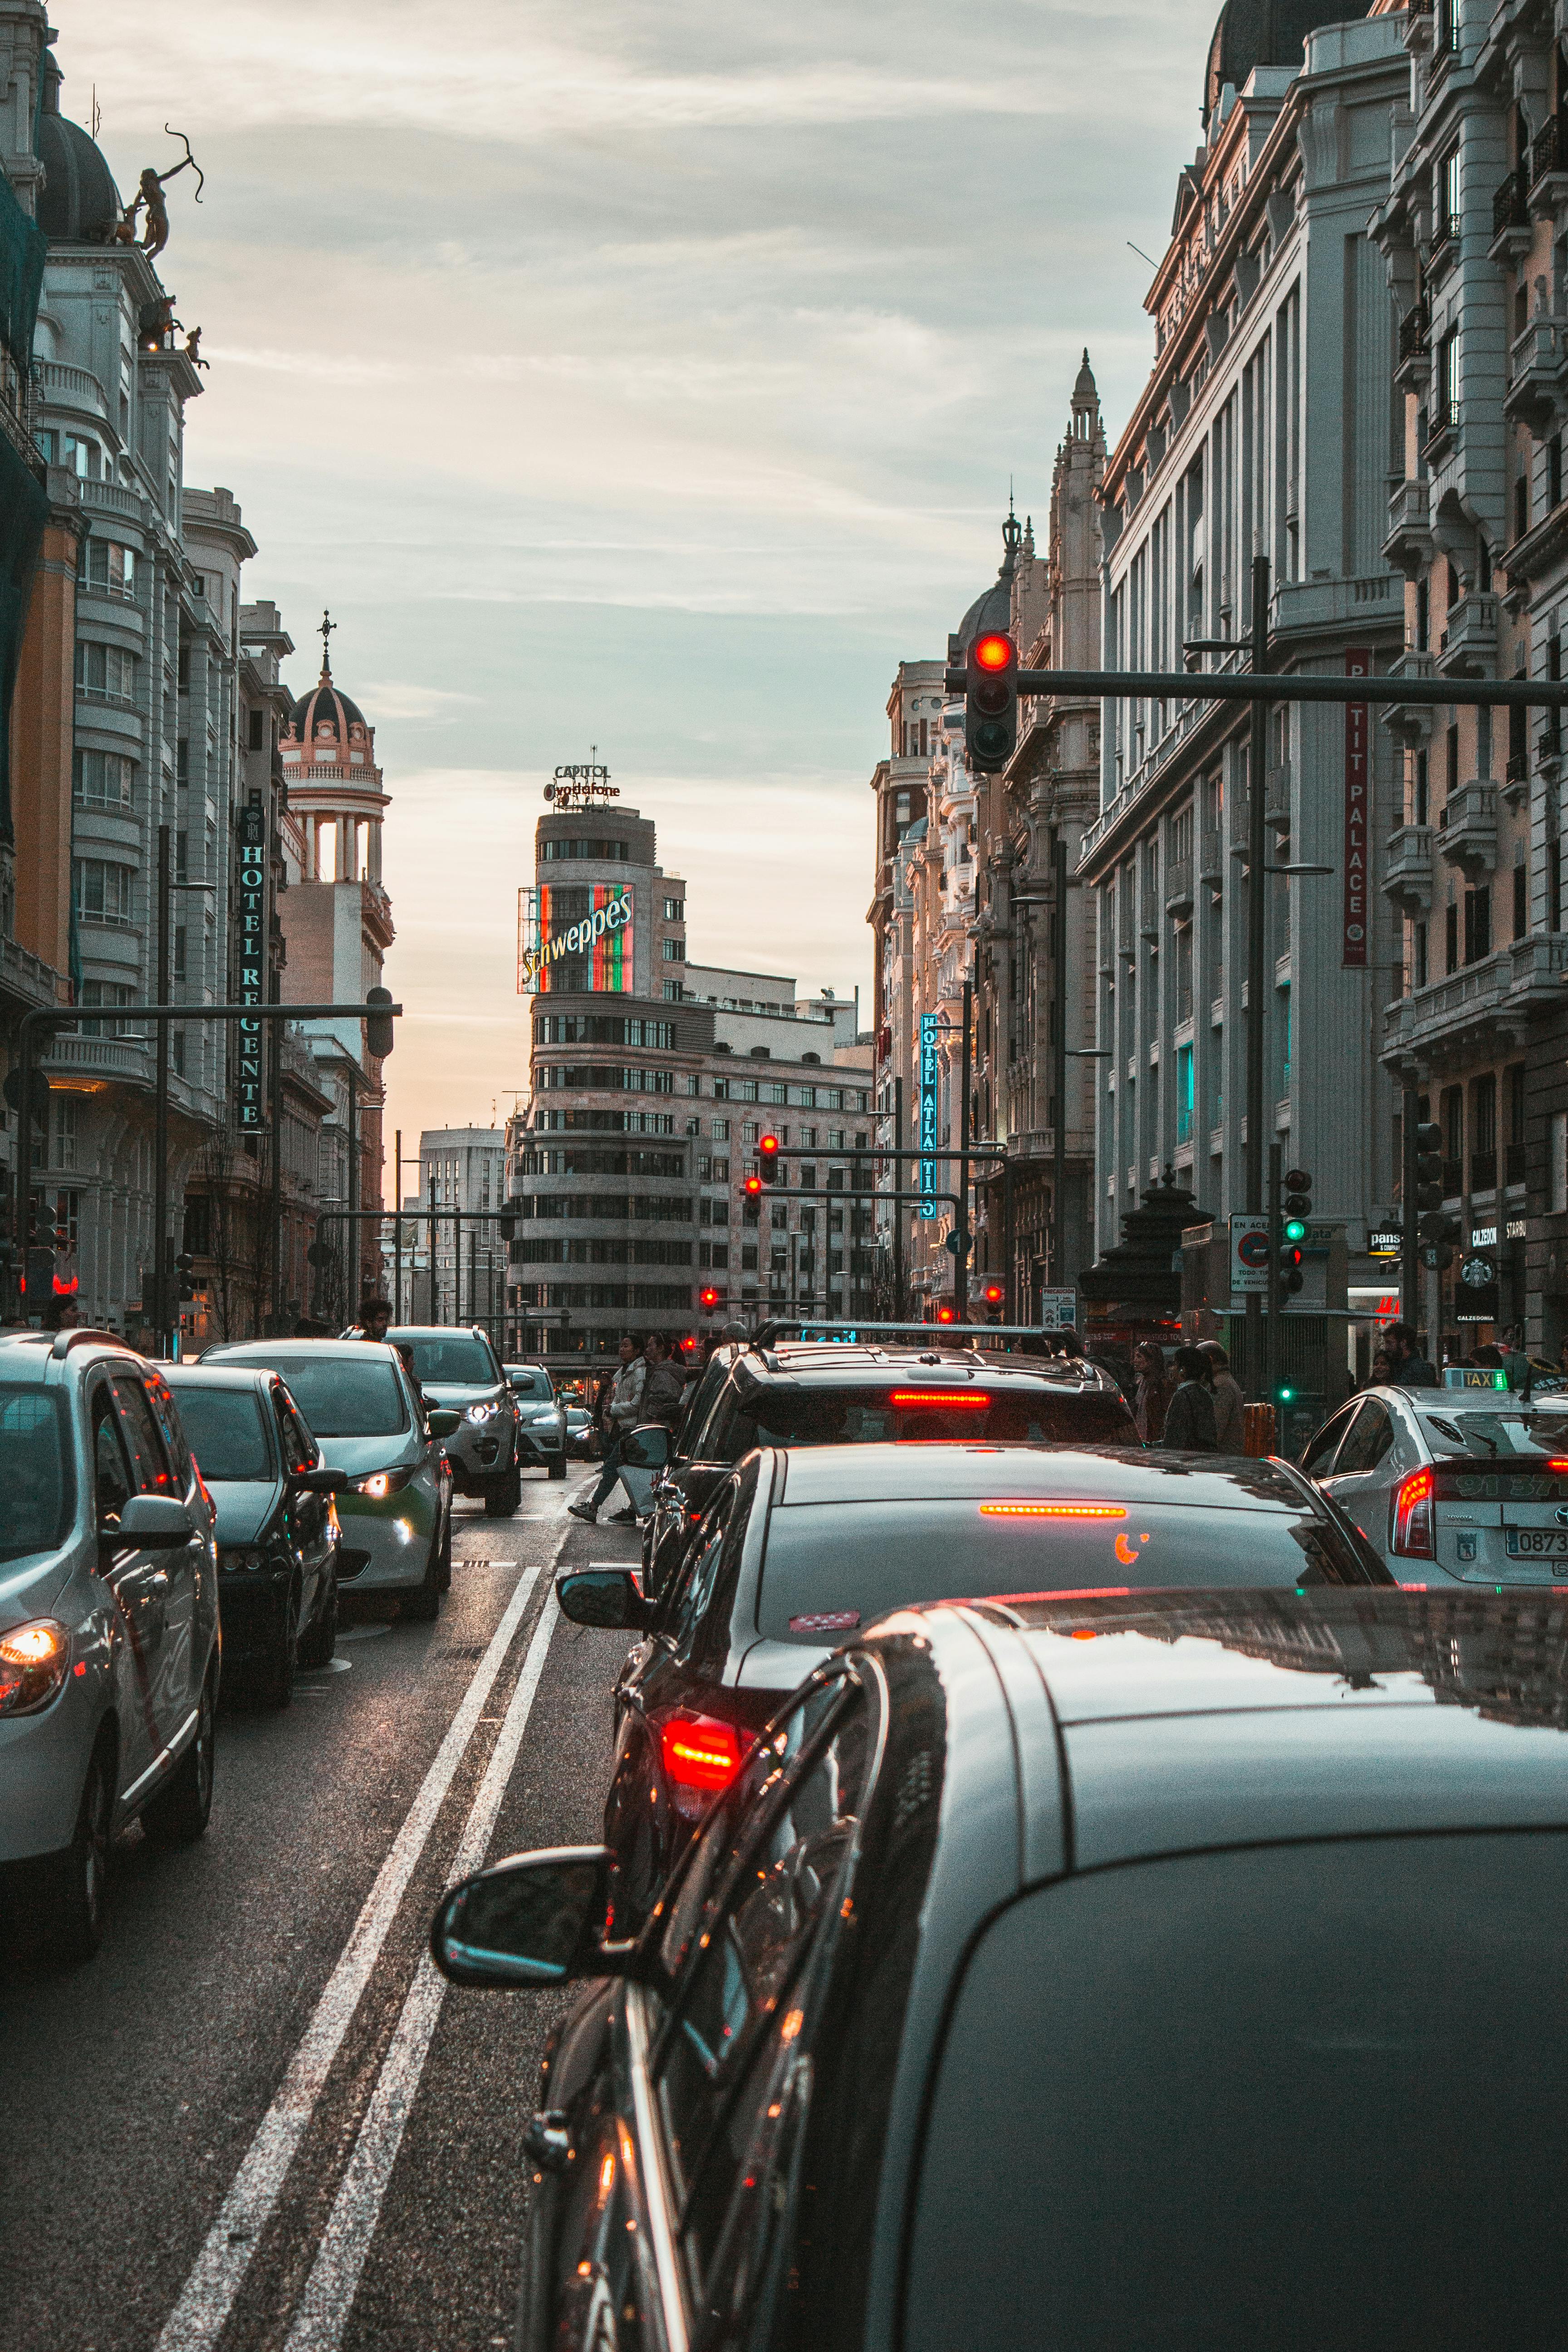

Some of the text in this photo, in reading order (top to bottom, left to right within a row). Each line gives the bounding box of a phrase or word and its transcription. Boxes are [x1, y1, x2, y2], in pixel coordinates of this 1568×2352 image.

[554, 765, 611, 778] CAPITOL
[555, 782, 620, 796] vodafone
[1349, 666, 1363, 913] PTIT PALACE
[522, 892, 632, 985] Schweppes
[240, 847, 263, 1123] HOTEL REGENTE
[923, 1017, 935, 1216] HOTEL ATLATIO
[1472, 1227, 1497, 1247] CALZEDON
[1506, 1220, 1526, 1239] STARBU
[1371, 1234, 1401, 1246] pans
[1464, 1372, 1494, 1387] TAXI
[1456, 1474, 1498, 1496] 91
[1520, 1533, 1568, 1552] 0873
